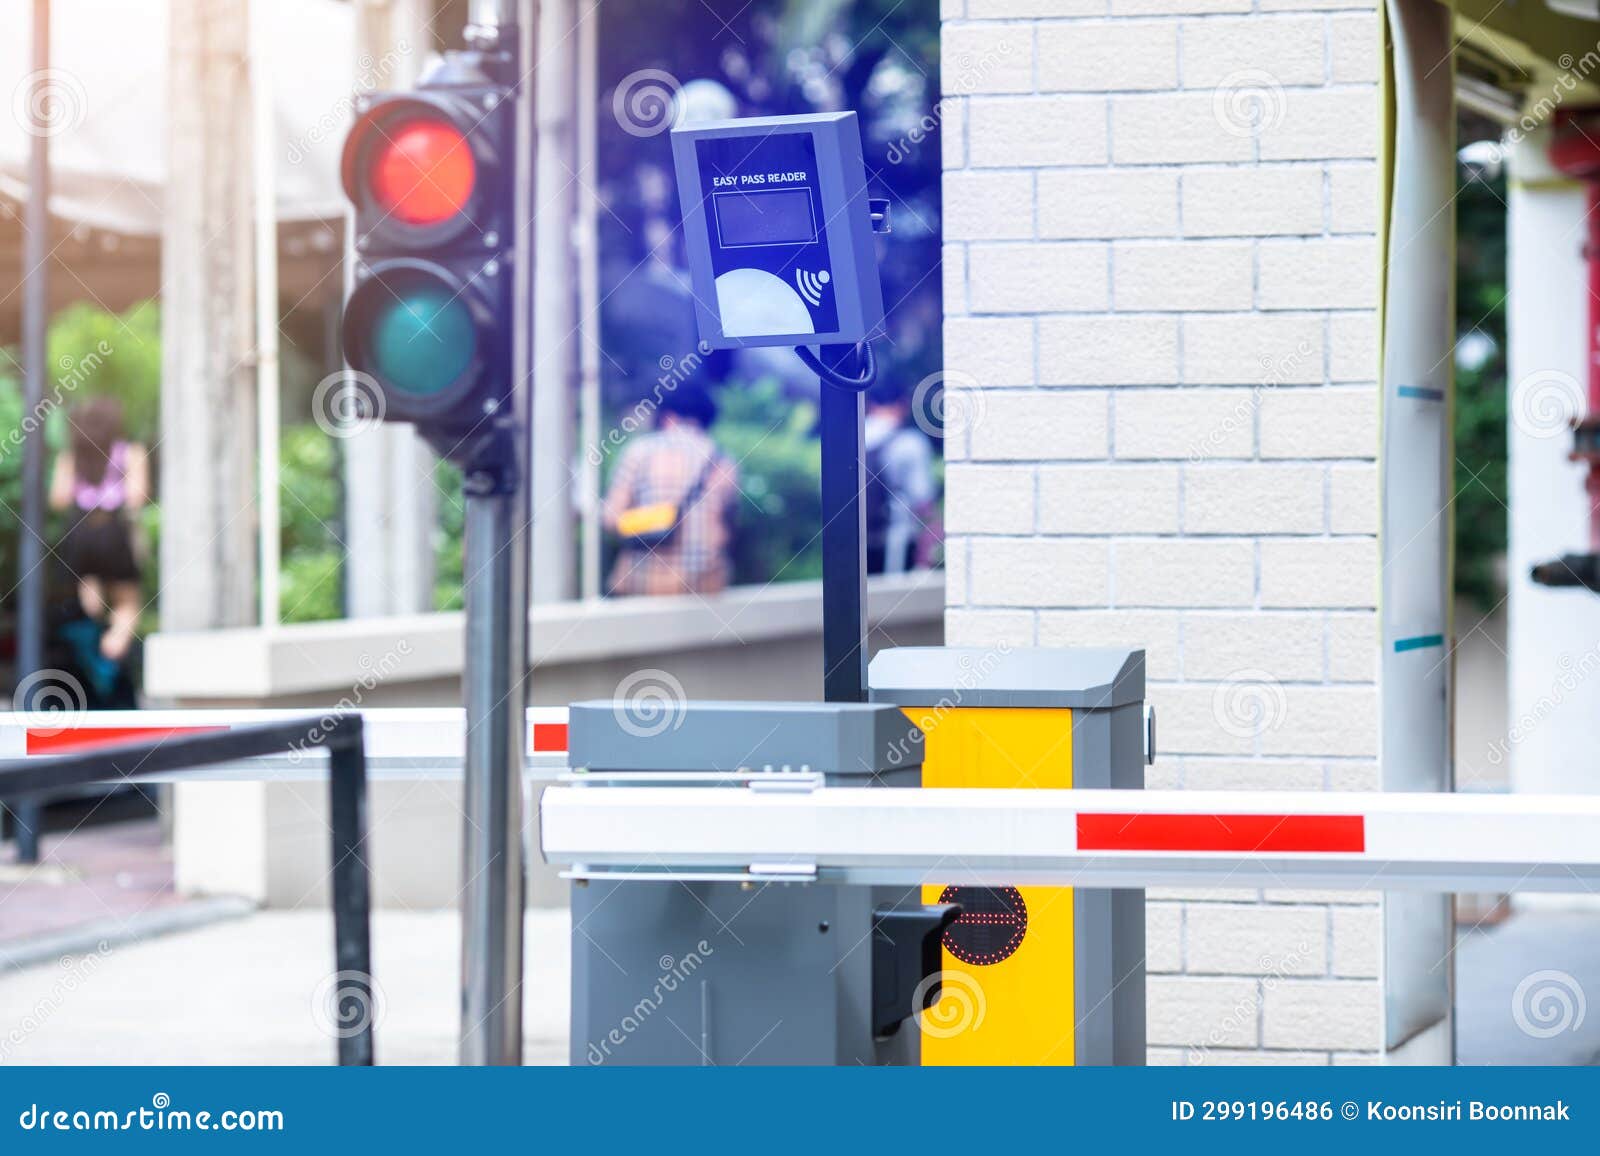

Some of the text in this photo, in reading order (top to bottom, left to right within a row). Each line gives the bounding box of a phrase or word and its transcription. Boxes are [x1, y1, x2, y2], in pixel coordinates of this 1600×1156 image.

[713, 171, 807, 187] EASY PASS READER
